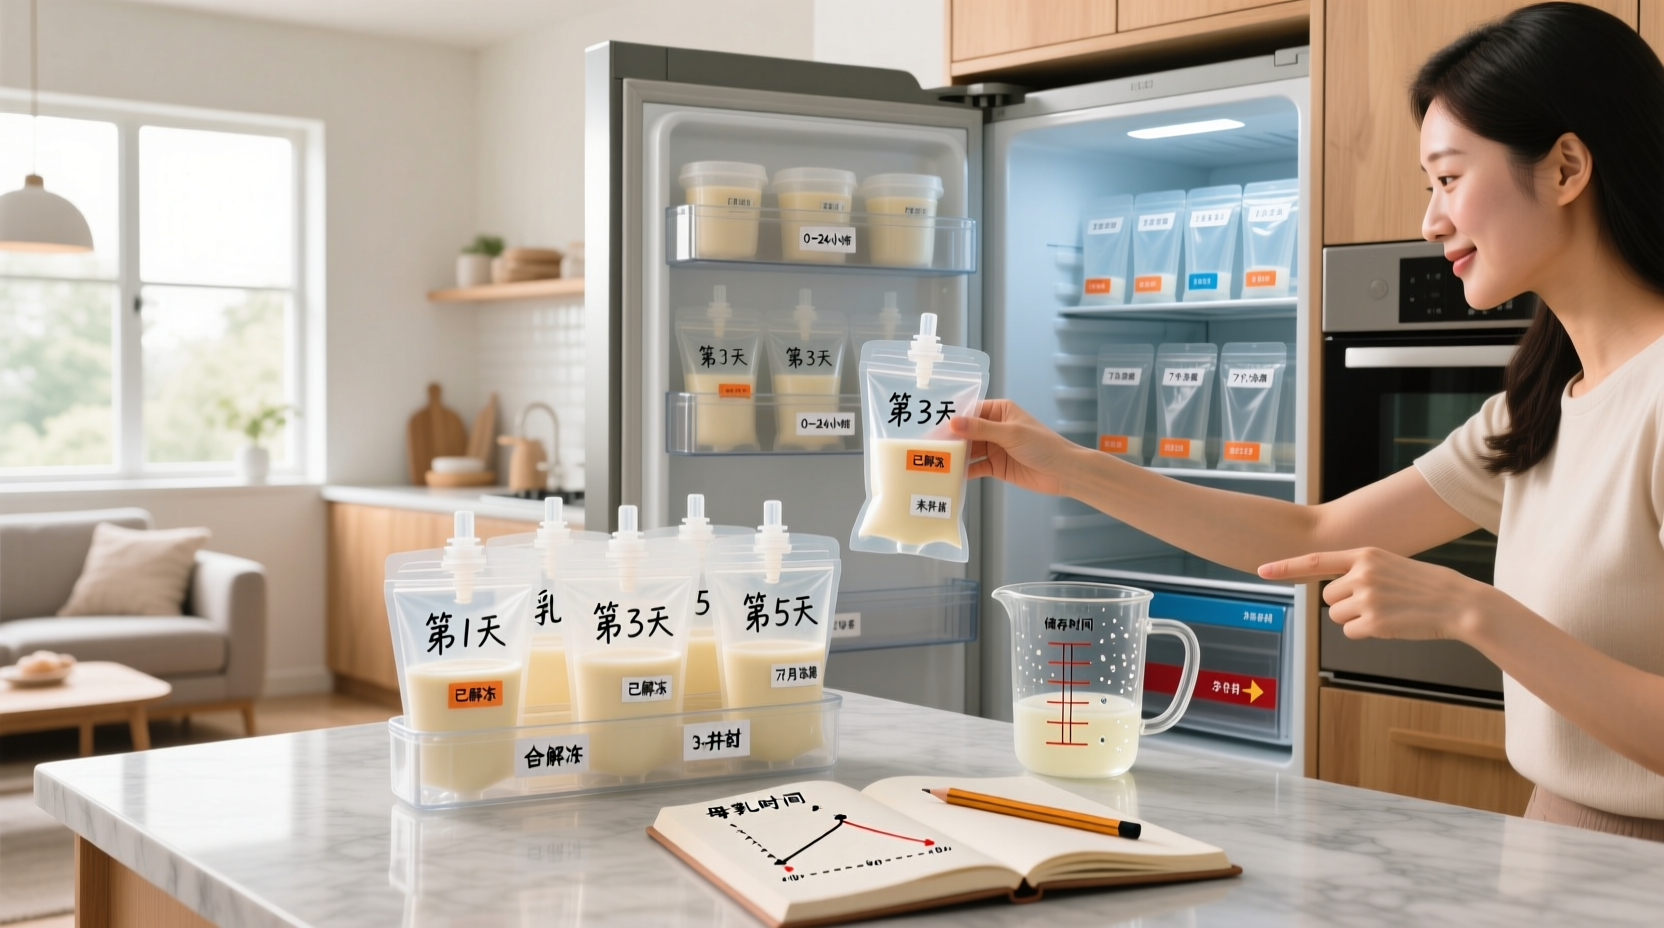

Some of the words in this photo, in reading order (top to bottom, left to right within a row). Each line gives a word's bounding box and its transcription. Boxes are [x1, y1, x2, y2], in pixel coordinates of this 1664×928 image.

[699, 345, 748, 369] 第3天
[786, 347, 833, 369] 第3天
[888, 392, 956, 427] 第3天
[534, 589, 562, 626] 乳
[695, 590, 710, 615] 5
[743, 592, 819, 632] 第5天
[426, 611, 506, 655] 第1天
[593, 601, 674, 644] 第3天
[455, 686, 497, 702] 已解冻
[706, 792, 806, 819] 母乳时间
